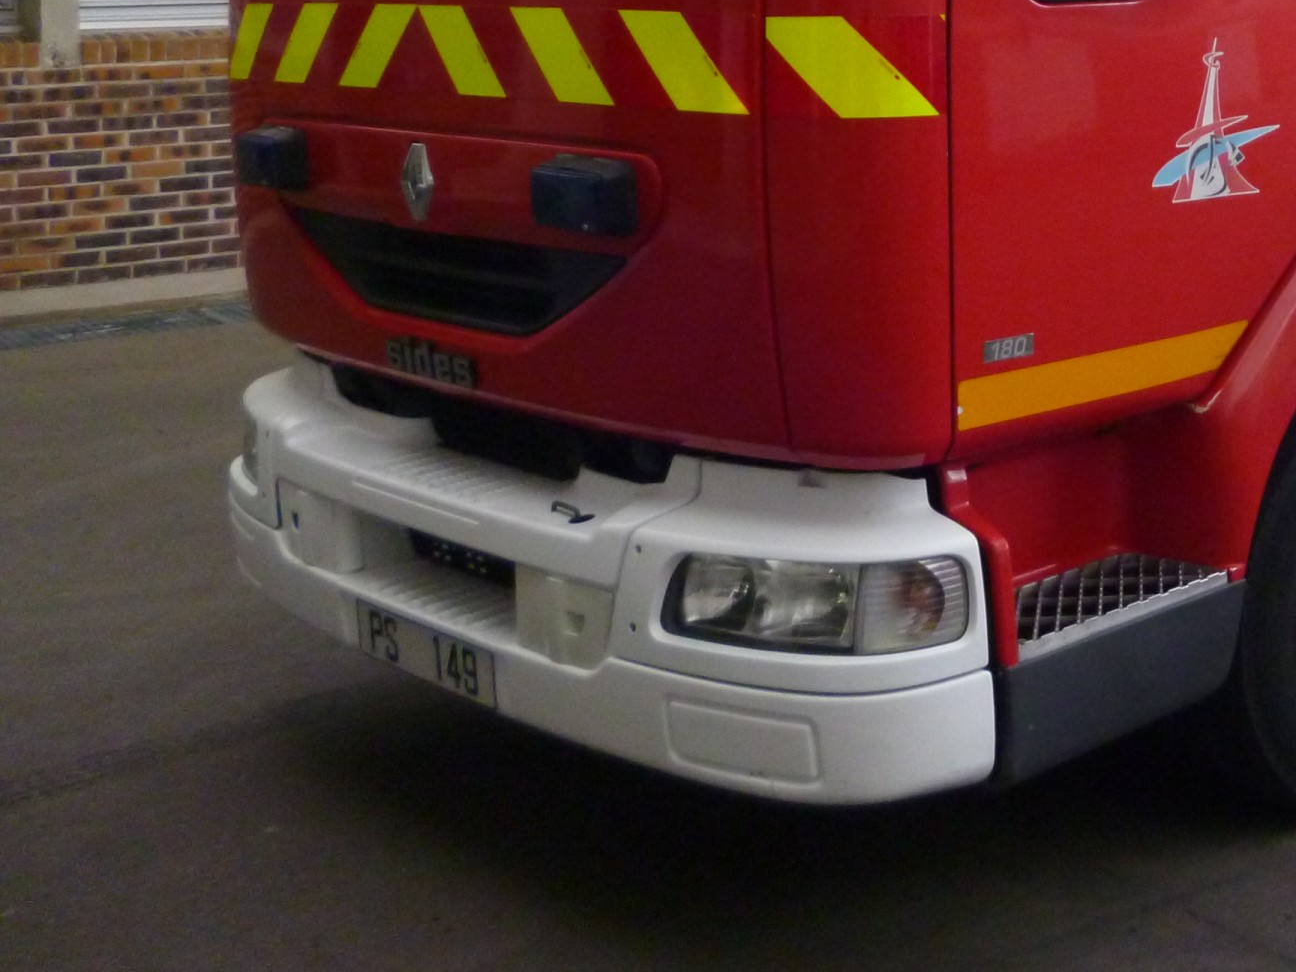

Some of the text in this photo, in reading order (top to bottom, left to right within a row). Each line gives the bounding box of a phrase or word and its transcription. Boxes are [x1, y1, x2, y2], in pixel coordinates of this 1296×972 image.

[386, 335, 473, 388] sides
[991, 336, 1026, 361] 180
[370, 611, 478, 695] PS 149
